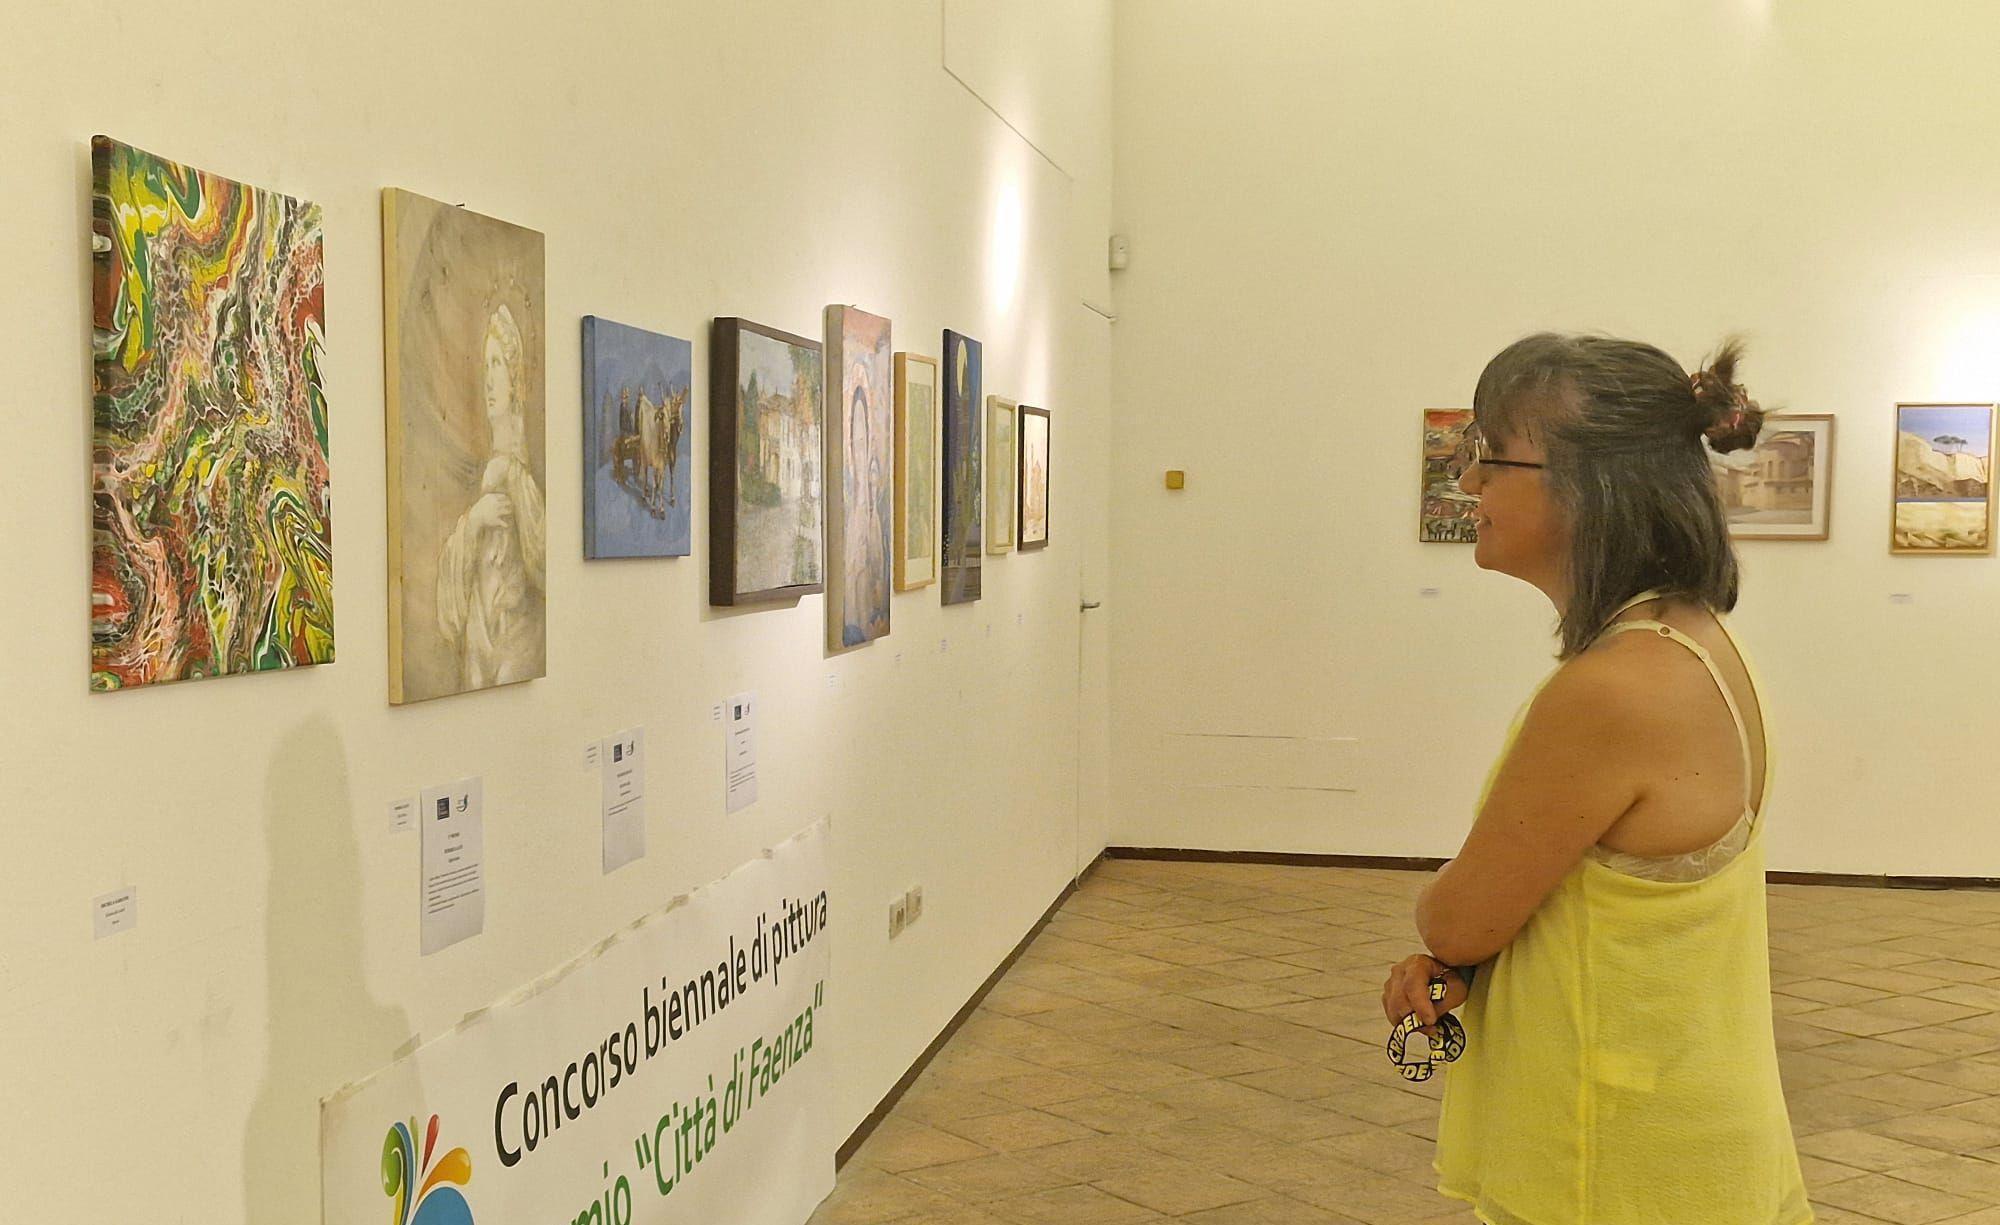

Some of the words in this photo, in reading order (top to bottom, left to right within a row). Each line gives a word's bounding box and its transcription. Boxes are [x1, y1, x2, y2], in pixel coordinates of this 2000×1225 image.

[494, 1021, 639, 1168] Concorso
[643, 935, 747, 1060] biennale
[751, 911, 769, 984] di
[770, 889, 828, 986] pittura
[634, 1073, 717, 1196] "Città
[723, 1047, 744, 1134] di
[747, 980, 824, 1111] Faenza"
